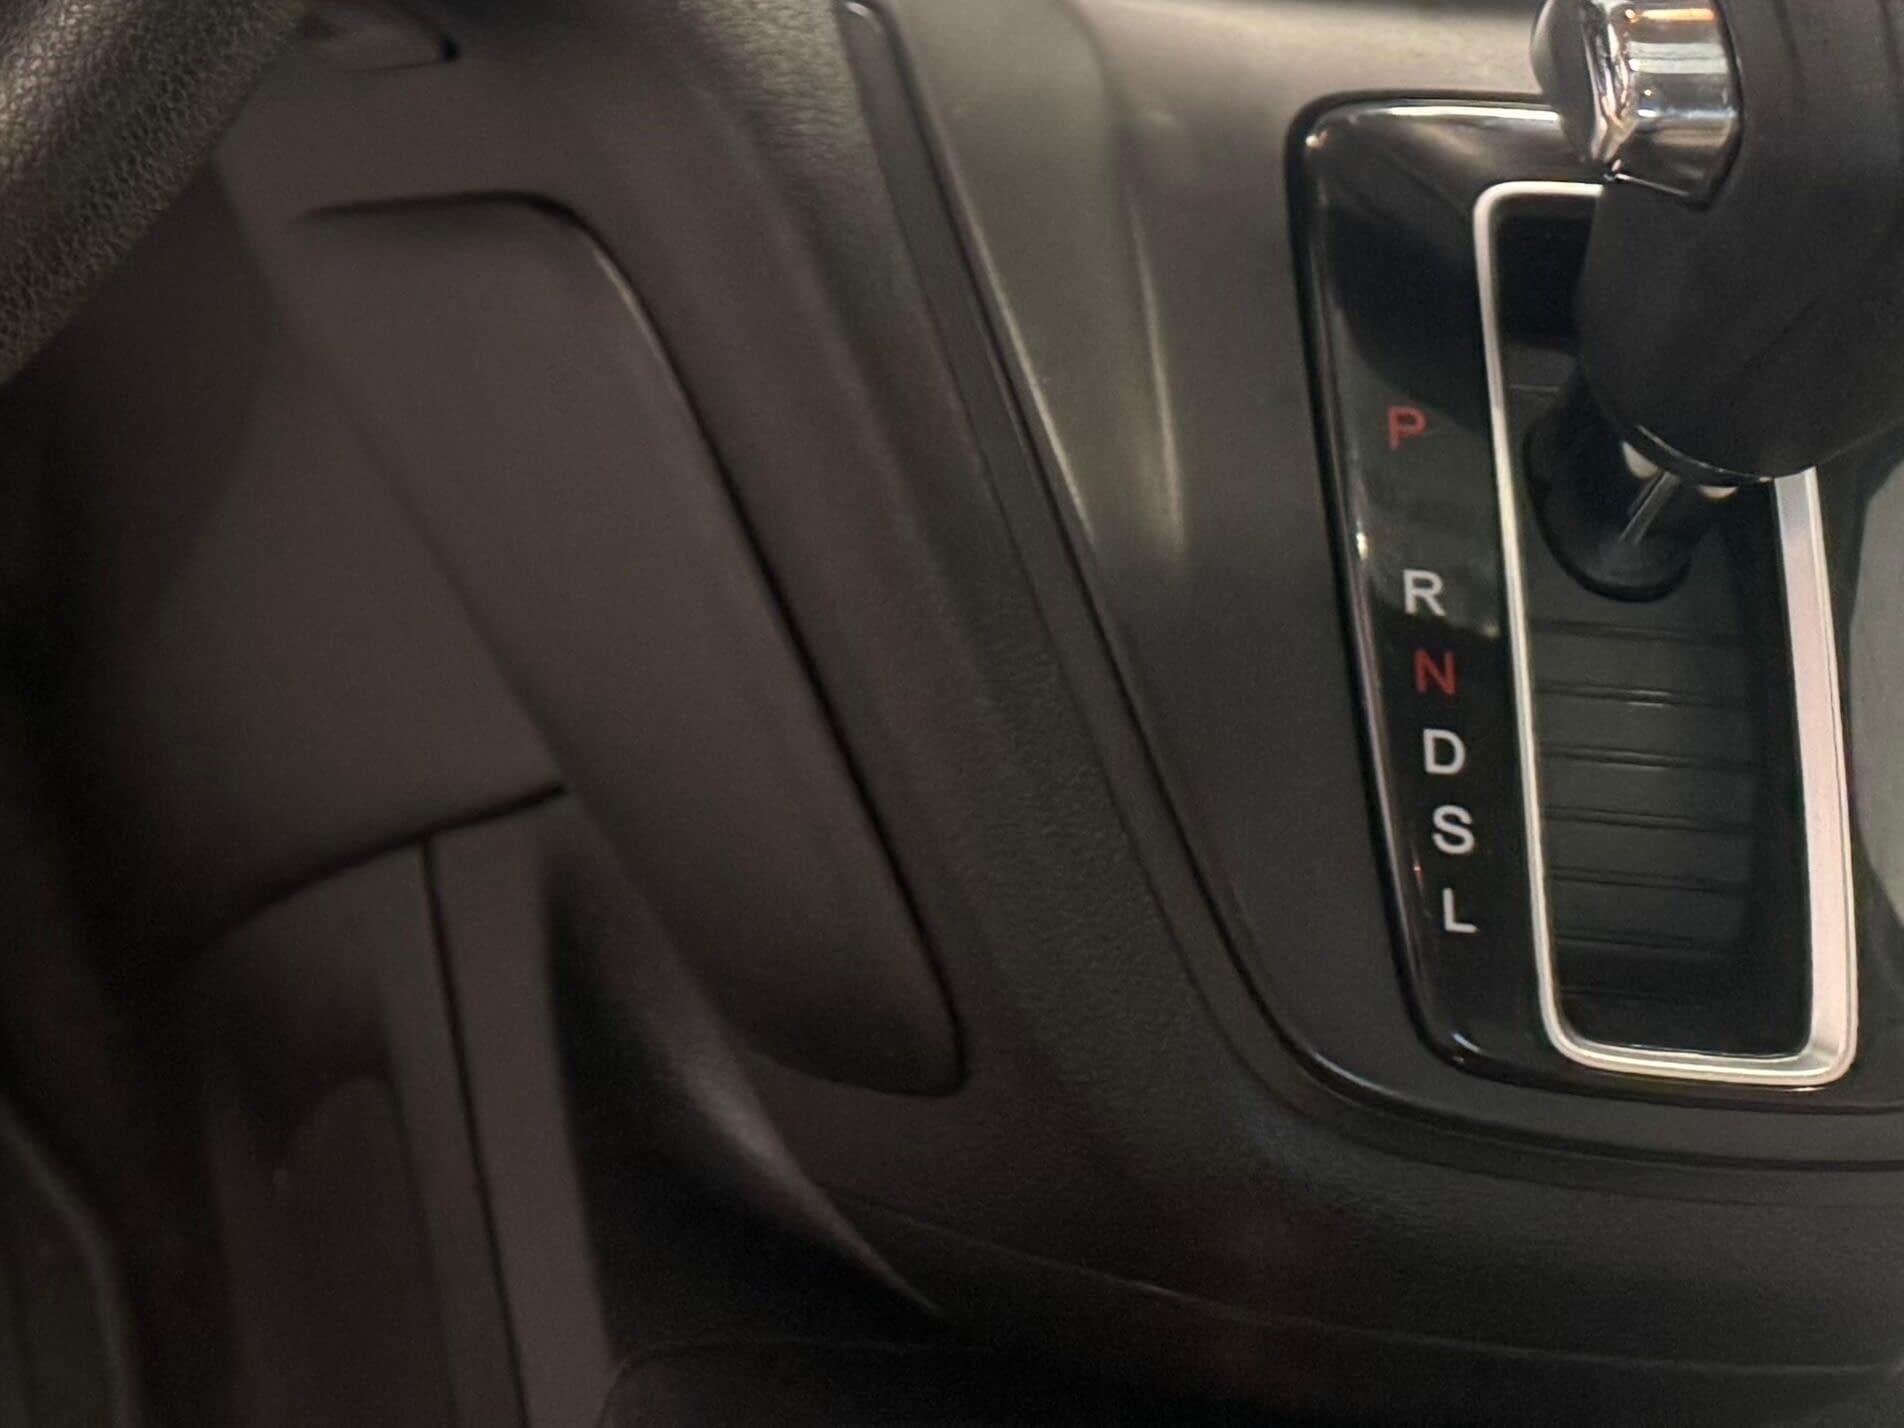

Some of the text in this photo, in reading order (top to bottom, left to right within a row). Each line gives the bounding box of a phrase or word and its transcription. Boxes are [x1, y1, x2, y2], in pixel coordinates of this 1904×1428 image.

[1387, 406, 1427, 448] P
[1403, 570, 1447, 616] R
[1414, 650, 1457, 695] N
[1424, 729, 1466, 775] D
[1432, 806, 1475, 855] S
[1442, 889, 1478, 932] L
